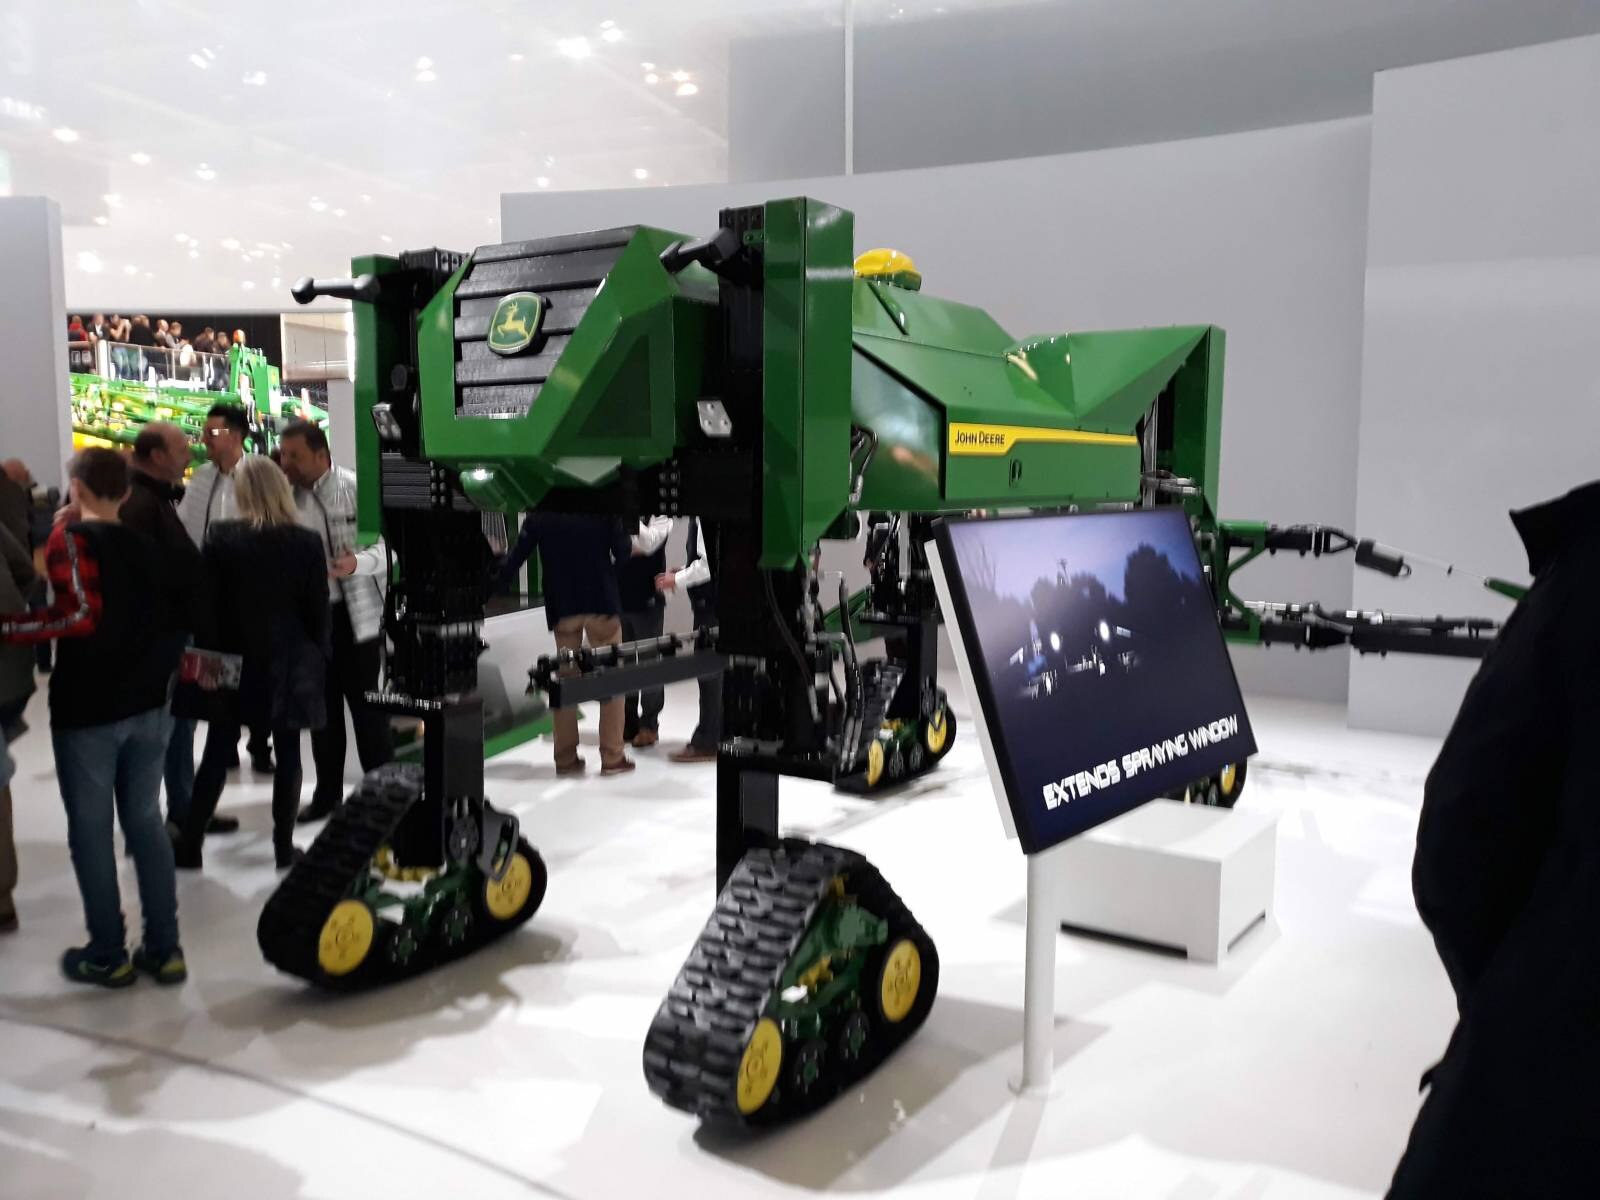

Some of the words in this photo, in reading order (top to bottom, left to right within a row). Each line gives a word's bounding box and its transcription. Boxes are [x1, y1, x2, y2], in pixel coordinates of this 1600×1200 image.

[955, 429, 977, 445] JOHN
[979, 431, 1005, 445] DEERE
[1042, 759, 1121, 810] EXTENDS
[1122, 734, 1188, 778] SPRAYING
[1188, 714, 1238, 751] WINDOW
